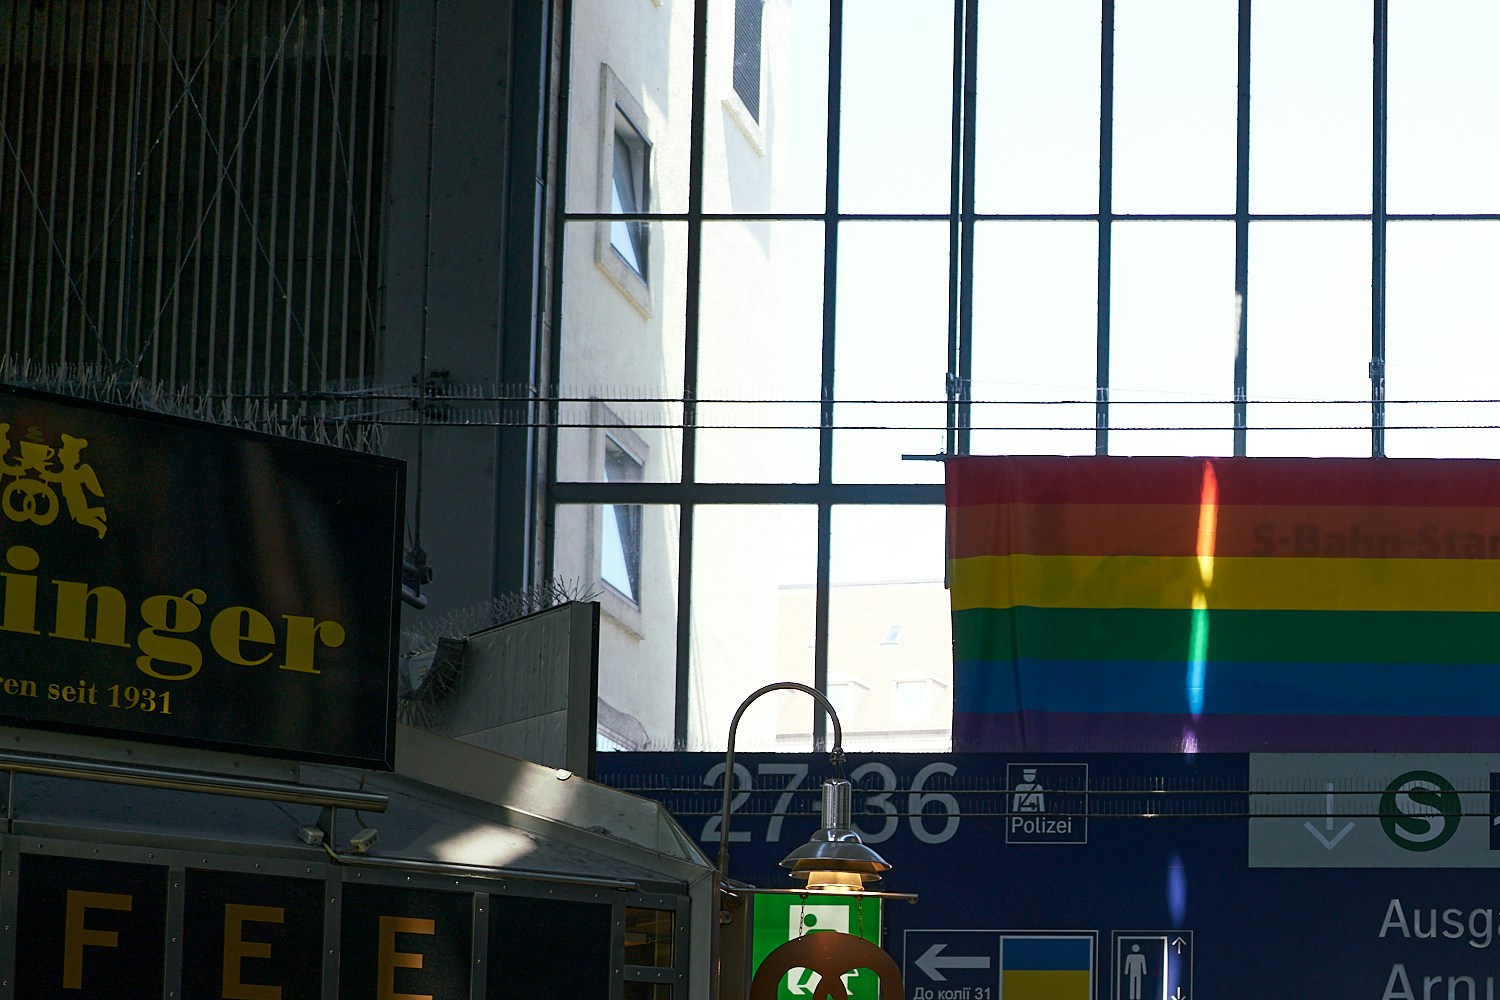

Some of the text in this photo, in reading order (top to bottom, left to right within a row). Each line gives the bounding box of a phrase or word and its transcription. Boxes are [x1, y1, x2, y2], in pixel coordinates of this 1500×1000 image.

[0, 545, 346, 681] inger
[0, 677, 173, 716] en seit 1931
[1011, 816, 1073, 838] Polizei
[939, 985, 972, 1000] колії
[975, 986, 991, 1000] 31
